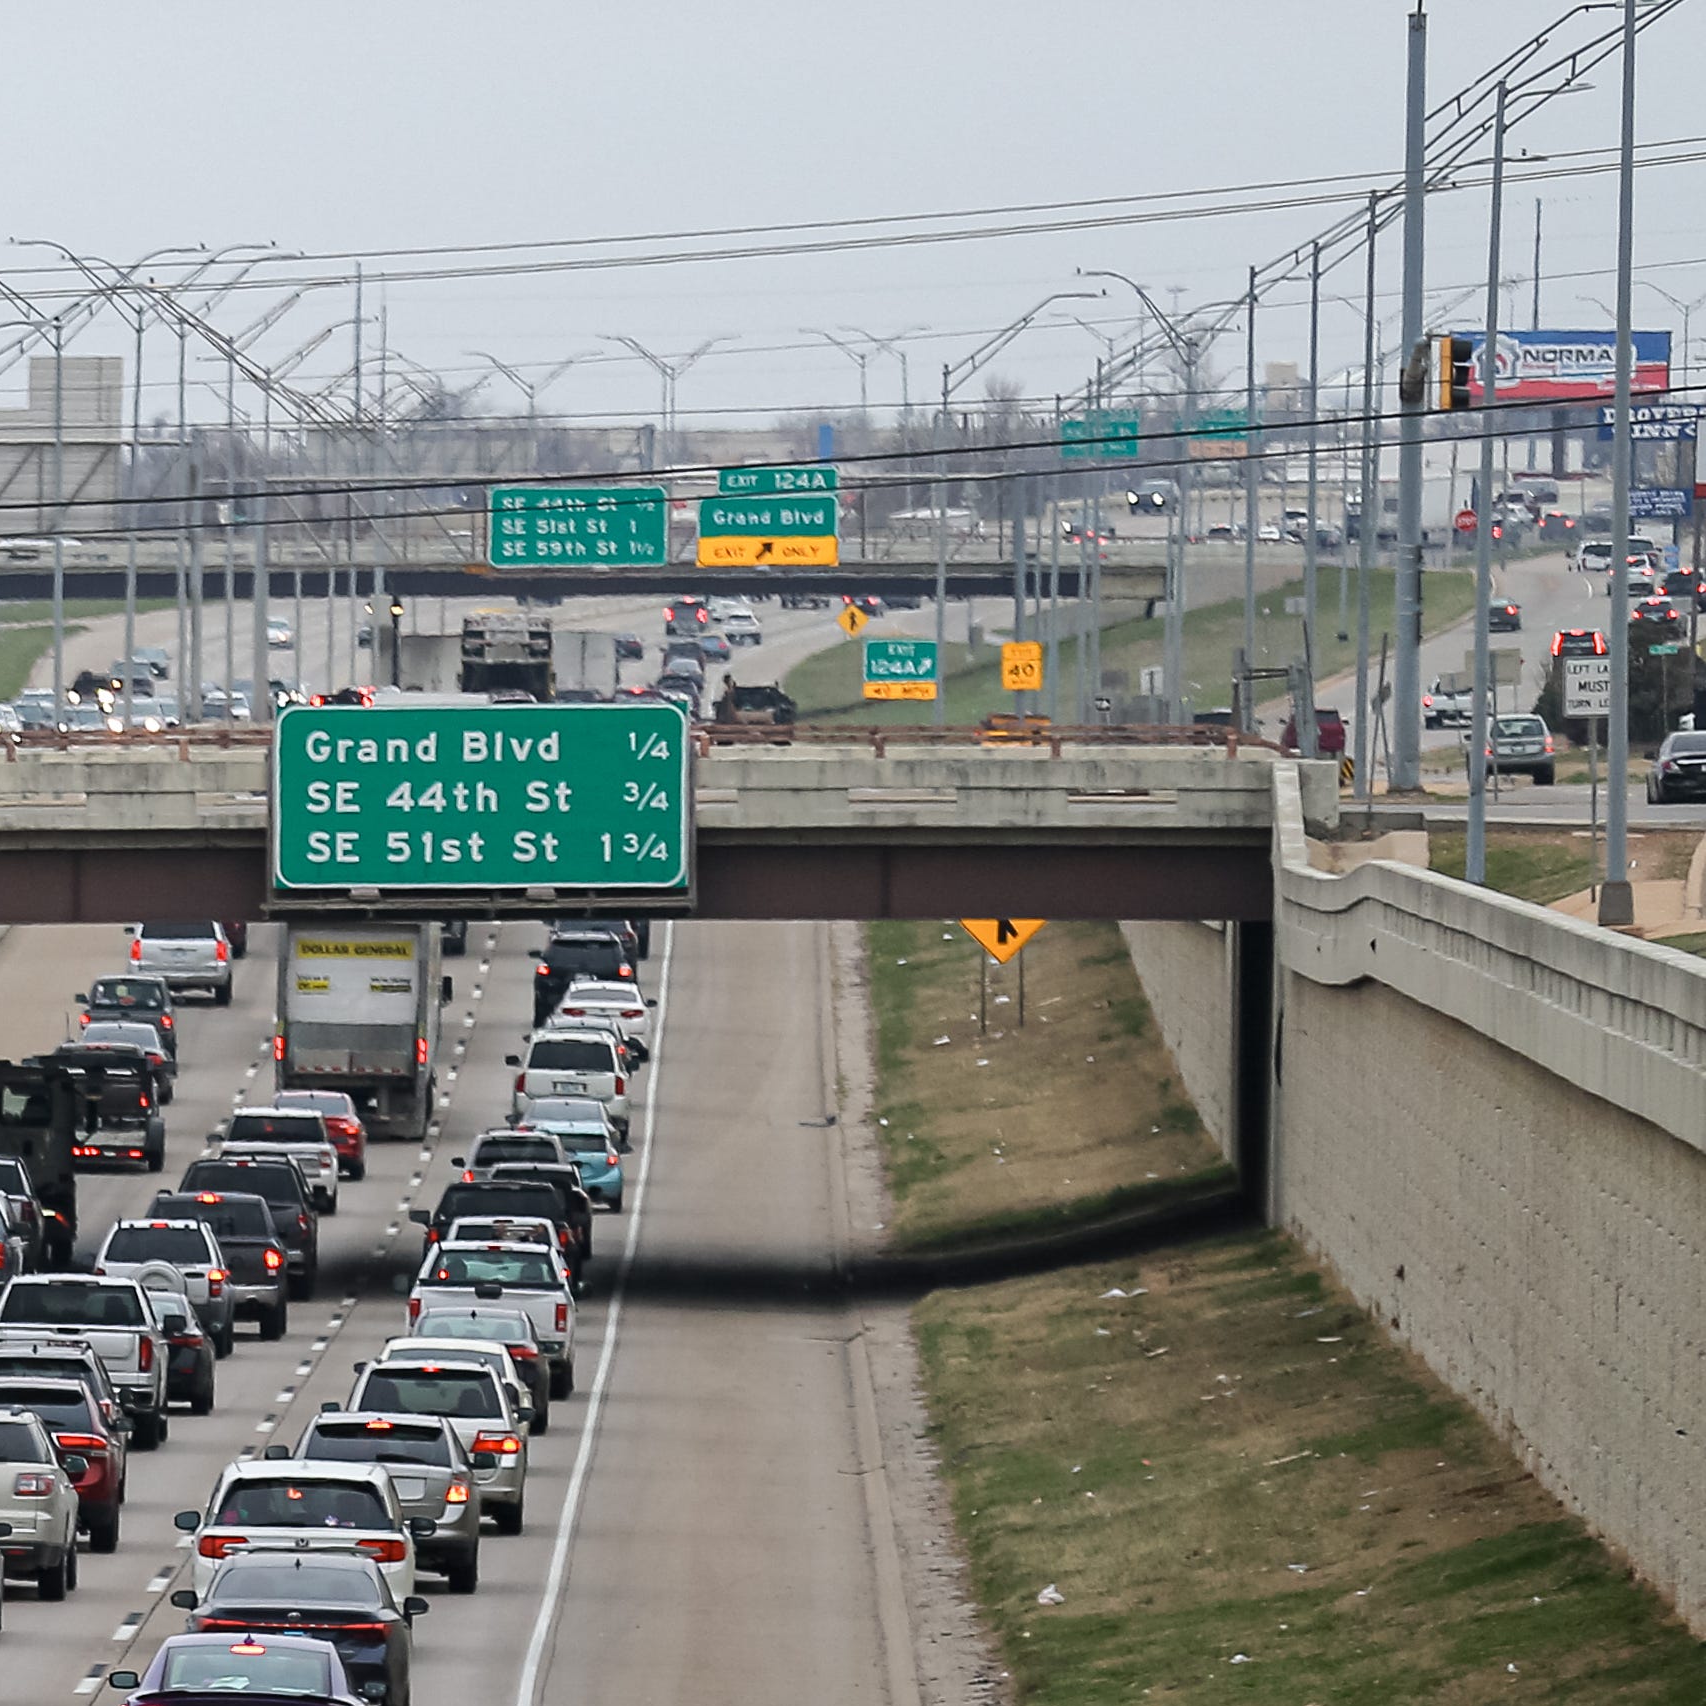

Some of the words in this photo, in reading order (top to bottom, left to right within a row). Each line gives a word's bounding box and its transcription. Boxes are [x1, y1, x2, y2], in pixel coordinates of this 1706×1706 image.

[1523, 348, 1615, 363] NORMA
[1631, 424, 1681, 438] INN
[726, 475, 758, 487] EXIT
[774, 472, 826, 489] 124A
[501, 497, 526, 514] SE
[537, 497, 587, 514] 44th
[597, 496, 618, 513] St
[713, 509, 771, 526] Grand
[781, 507, 825, 525] Blvd
[501, 519, 526, 535] SE
[537, 519, 577, 534] 51st
[586, 519, 608, 534] St
[630, 520, 637, 534] 1
[501, 541, 526, 557] SE
[537, 541, 586, 557] 59th
[597, 541, 618, 556] St
[714, 547, 745, 558] EXIT
[783, 546, 820, 558] ONLY
[888, 644, 915, 656] EXIT
[871, 659, 916, 675] 124A
[1008, 664, 1035, 678] 40
[1568, 664, 1589, 675] LEFT
[1578, 682, 1610, 692] MUST
[1568, 700, 1591, 709] TURN
[305, 731, 437, 763] Grand
[462, 731, 560, 763] Blvd
[629, 732, 670, 760] 1/4
[306, 782, 361, 813] SE
[386, 781, 499, 813] 44th
[525, 781, 572, 813] St
[623, 782, 669, 811] 3/4
[306, 832, 360, 863] SE
[386, 831, 485, 863] 51st
[513, 832, 559, 863] St
[301, 944, 349, 954] DOLLAR
[354, 944, 408, 956] GENERAL
